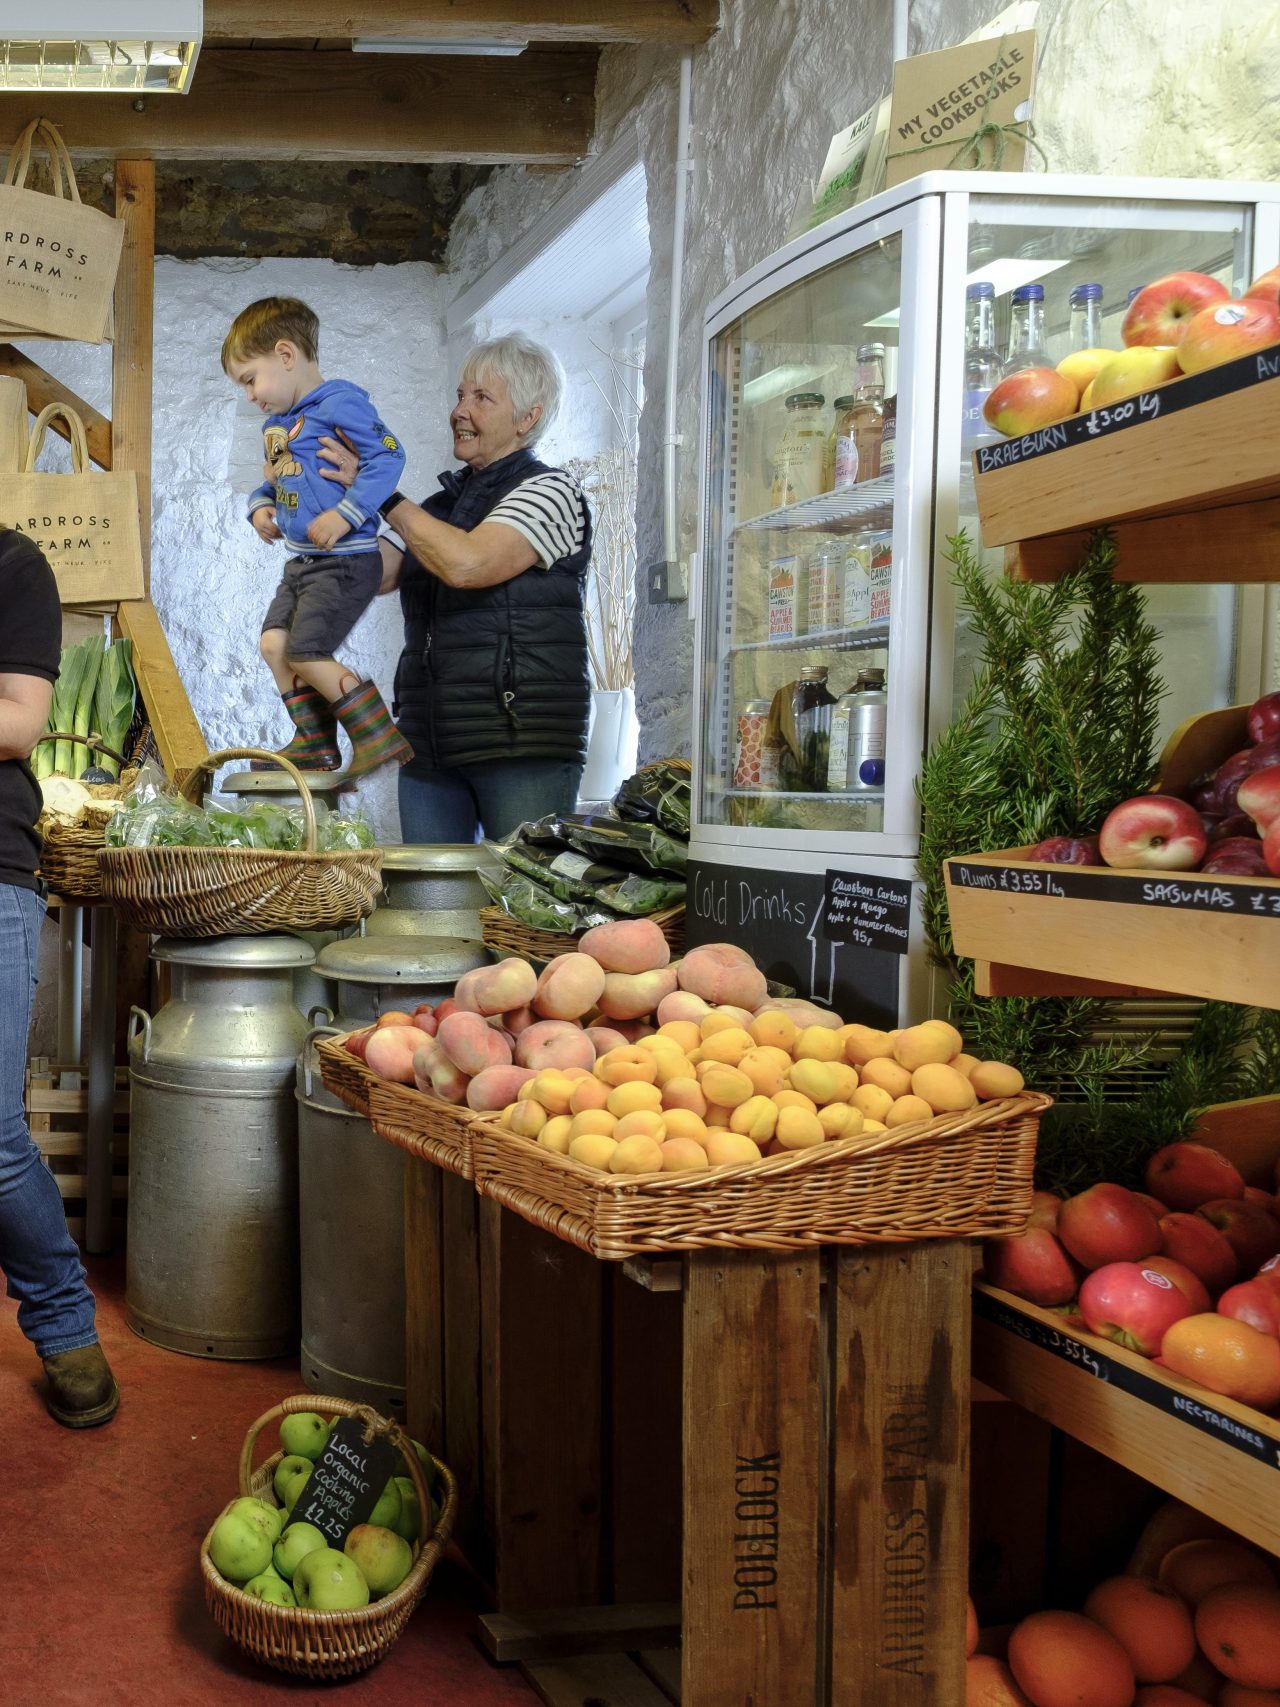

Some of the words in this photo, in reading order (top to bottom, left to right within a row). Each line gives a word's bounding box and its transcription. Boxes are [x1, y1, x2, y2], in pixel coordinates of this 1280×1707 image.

[897, 115, 923, 140] MY
[926, 48, 1025, 118] VEGETABLE
[920, 71, 1022, 145] COOKBOOKS
[850, 111, 872, 141] KALE
[7, 256, 61, 278] FARM
[980, 424, 1066, 472] BRAEBURN
[1086, 402, 1135, 434] £3.00
[14, 516, 111, 532] ARDROSS
[37, 538, 91, 550] FARM
[695, 870, 728, 926] Cold
[739, 881, 805, 925] Drinks
[832, 877, 873, 897] Cawston
[877, 887, 907, 904] Cartons
[832, 896, 850, 909] Apple
[1143, 884, 1235, 908] SATSUMAS
[827, 912, 845, 924] Apple
[1173, 1396, 1264, 1448] NECTARINES
[329, 1434, 367, 1473] Local
[304, 1502, 345, 1539] £2.25
[734, 1451, 781, 1610] POLLOCK
